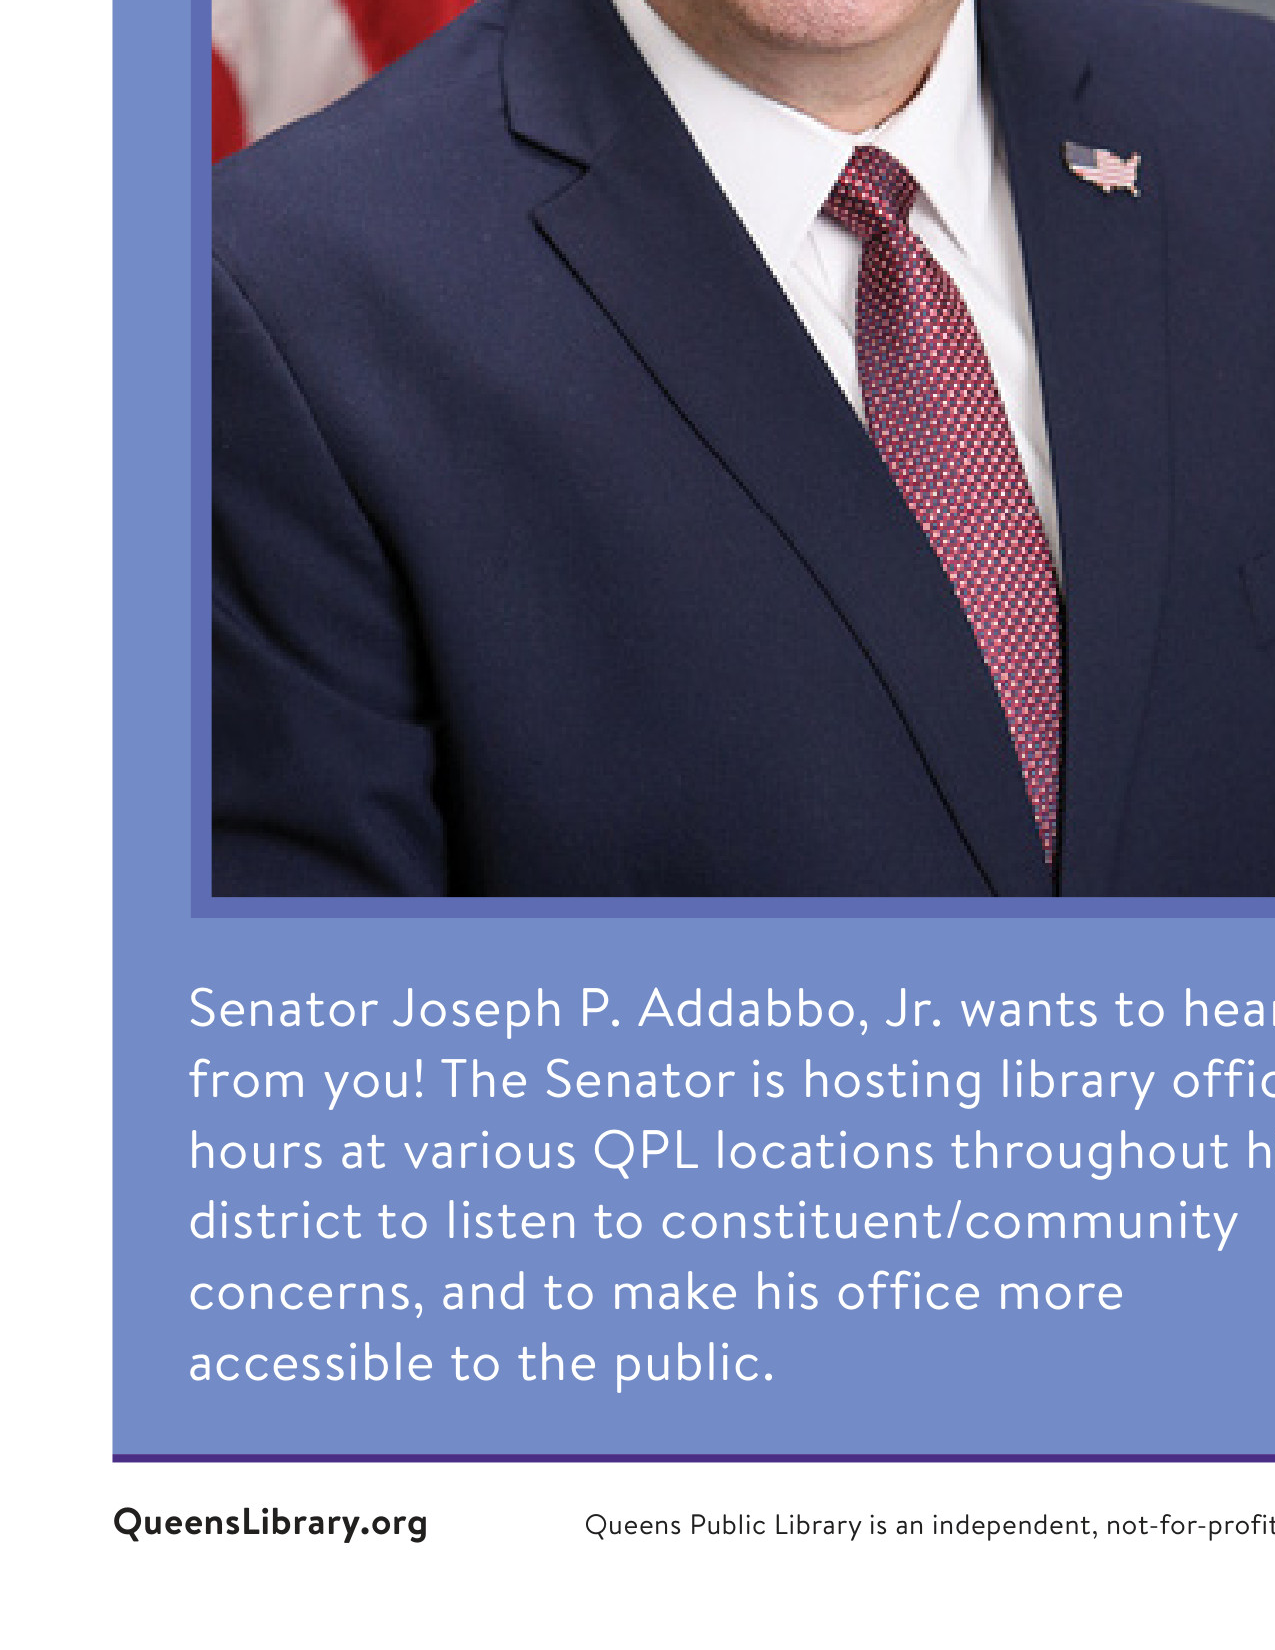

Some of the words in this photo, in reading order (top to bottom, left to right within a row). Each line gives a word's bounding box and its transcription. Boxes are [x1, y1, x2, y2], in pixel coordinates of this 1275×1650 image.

[191, 987, 378, 1027] Senator
[393, 988, 559, 1039] Joseph
[583, 988, 619, 1027] P.
[638, 987, 867, 1035] Addabbo,
[886, 988, 940, 1027] Jr.
[961, 993, 1097, 1027] wants
[1115, 993, 1164, 1027] to
[189, 1058, 303, 1098] from
[325, 1059, 422, 1110] you!
[441, 1059, 526, 1098] The
[547, 1058, 735, 1098] Senator
[753, 1060, 784, 1098] is
[806, 1059, 980, 1109] hosting
[1003, 1059, 1155, 1110] library
[192, 1130, 322, 1169] hours
[342, 1135, 385, 1169] at
[404, 1131, 575, 1169] various
[595, 1129, 698, 1179] QPL
[718, 1130, 933, 1169] locations
[951, 1130, 1228, 1180] throughout
[191, 1200, 361, 1239] district
[378, 1205, 427, 1239] to
[449, 1200, 574, 1239] listen
[594, 1205, 642, 1239] to
[663, 1200, 1238, 1251] constituent/community
[191, 1283, 422, 1318] concerns,
[443, 1271, 524, 1310] and
[544, 1276, 593, 1310] to
[615, 1271, 736, 1310] make
[758, 1271, 818, 1310] his
[838, 1270, 979, 1310] office
[1001, 1283, 1122, 1310] more
[190, 1342, 432, 1381] accessible
[451, 1347, 499, 1381] to
[518, 1342, 595, 1381] the
[617, 1342, 772, 1393] public.
[114, 1507, 426, 1543] QueensLibrary.org
[586, 1514, 680, 1540] Queens
[692, 1514, 765, 1535] Public
[776, 1514, 862, 1541] Library
[934, 1514, 1097, 1541] independent,
